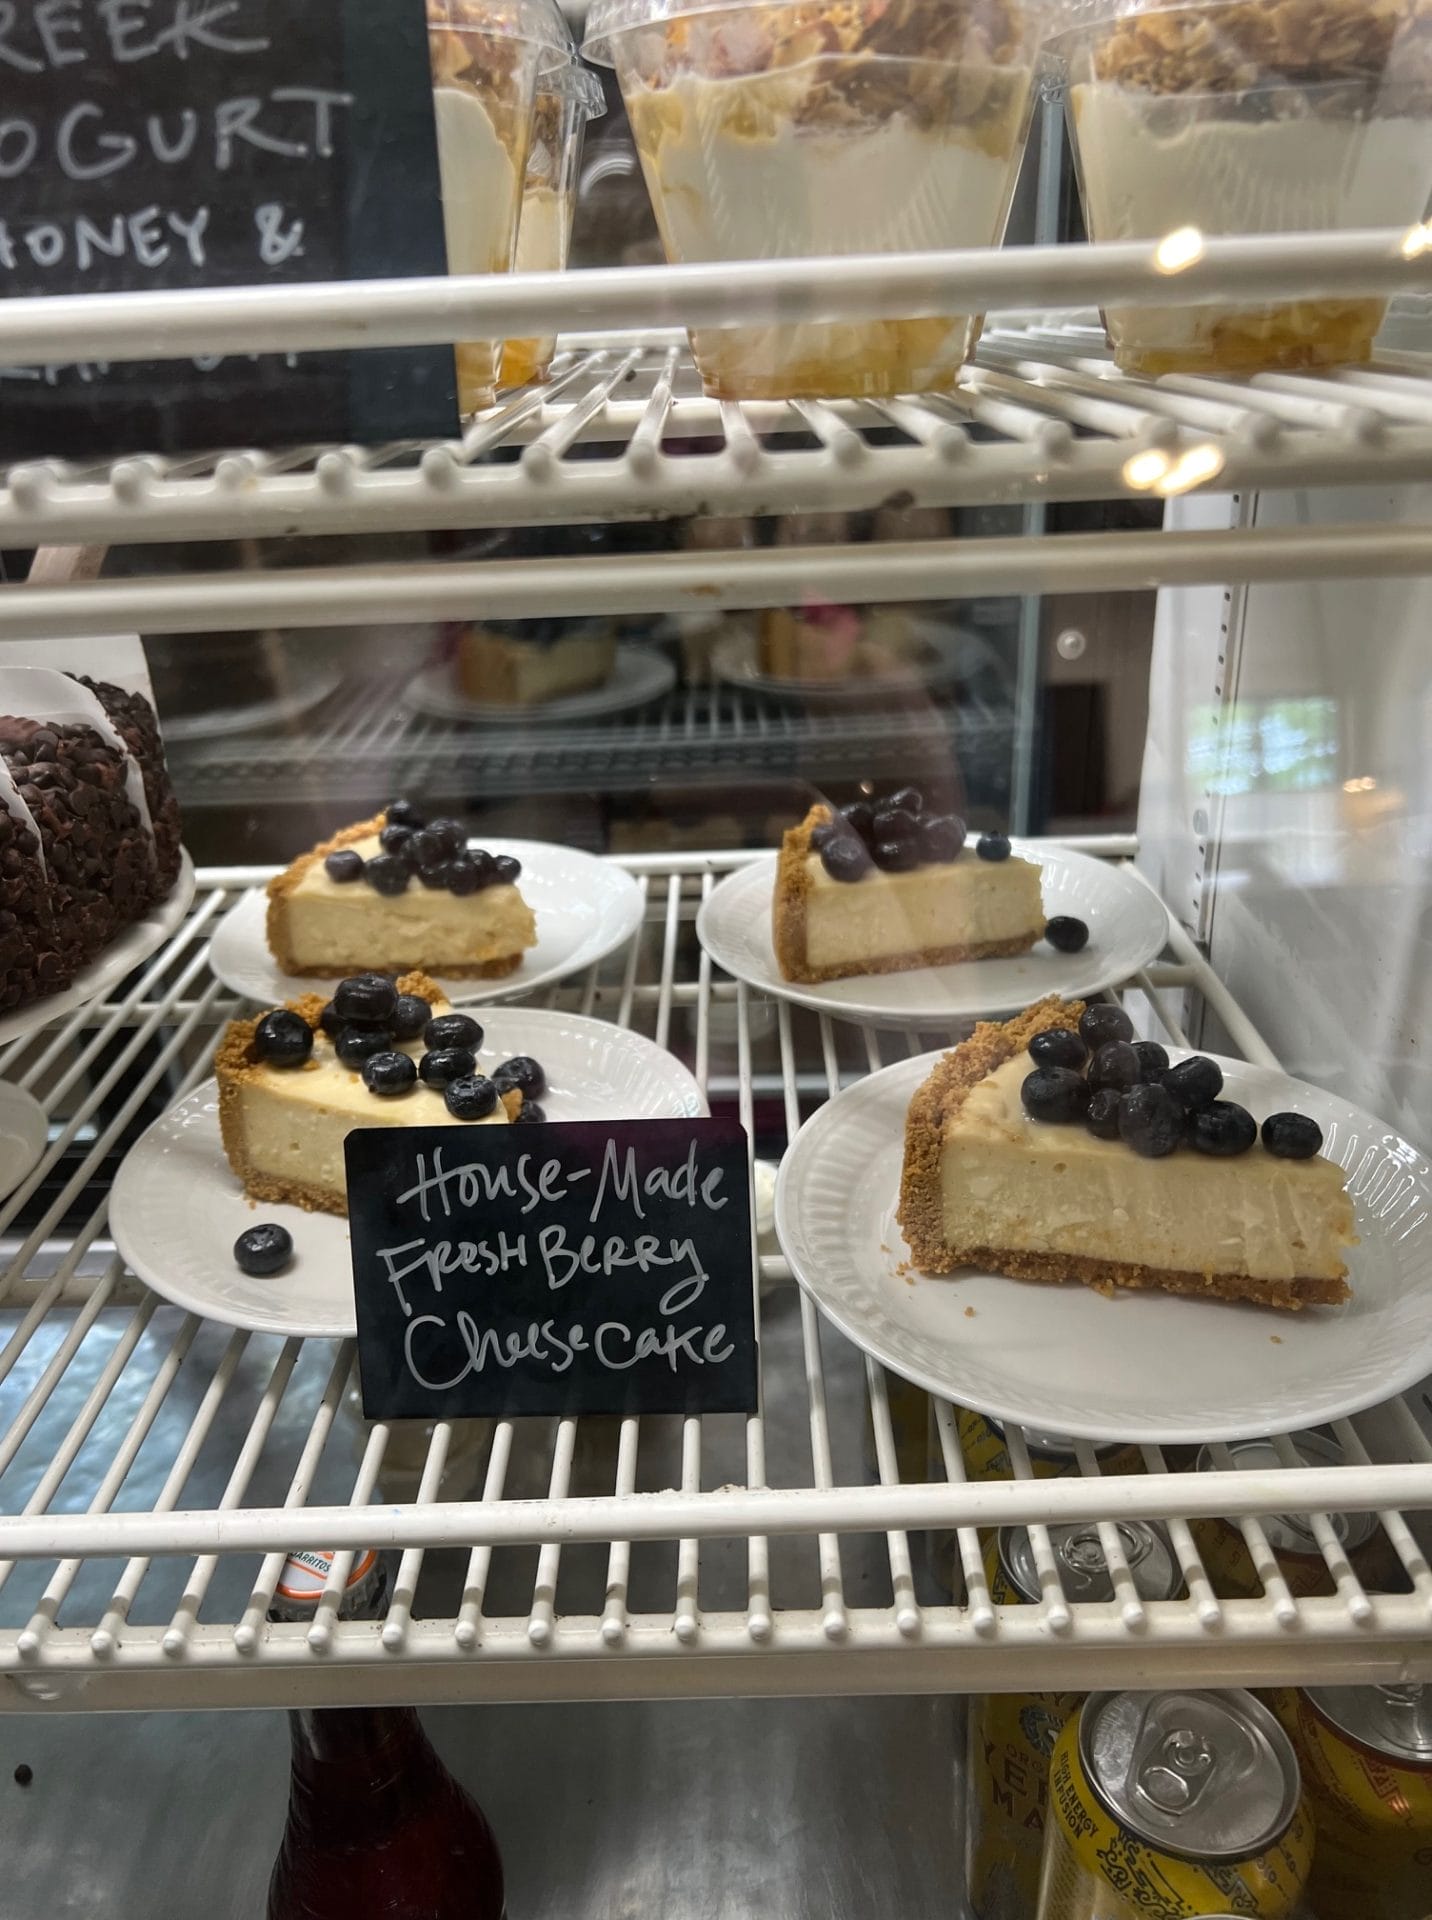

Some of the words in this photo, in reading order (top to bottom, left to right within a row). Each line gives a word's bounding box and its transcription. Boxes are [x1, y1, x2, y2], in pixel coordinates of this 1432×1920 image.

[0, 87, 355, 179] OGURT
[254, 203, 304, 265] &
[395, 1137, 729, 1222] House-Made
[1060, 1750, 1072, 1784] HIGH
[1053, 1770, 1084, 1839] INFUSION
[1065, 1784, 1100, 1838] ENERGY
